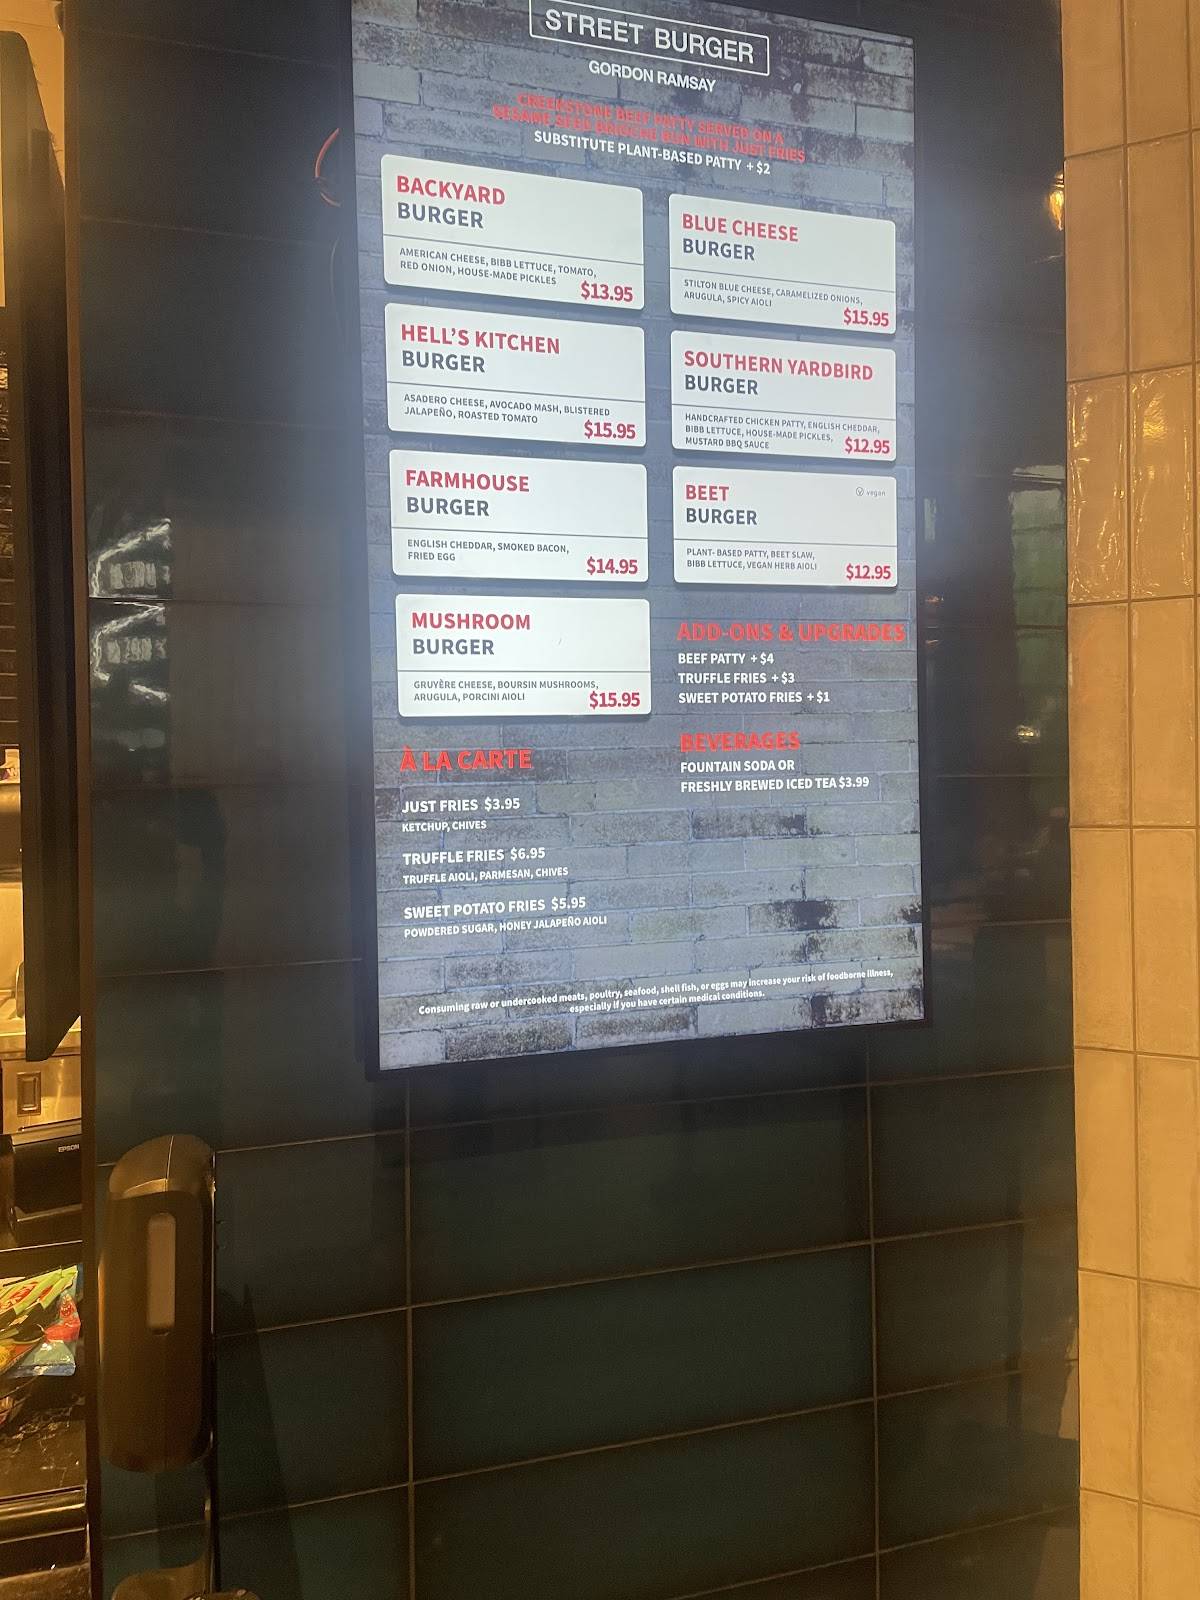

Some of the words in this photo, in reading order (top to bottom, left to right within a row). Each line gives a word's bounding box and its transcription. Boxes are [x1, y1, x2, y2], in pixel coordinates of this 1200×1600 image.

[545, 9, 643, 44] STREET
[655, 27, 753, 64] BURGER
[588, 60, 653, 83] GORDON
[657, 70, 716, 92] RAMSAY
[534, 130, 614, 153] SUBSTITUTE
[617, 142, 702, 165] PLANT-BASED
[705, 154, 741, 170] PATTY
[756, 160, 770, 175] $2
[768, 144, 805, 161] FRIES
[396, 175, 505, 205] BACKYARD
[397, 201, 483, 229] BURGER
[682, 213, 727, 234] BLUE
[732, 219, 798, 242] CHEESE
[682, 237, 754, 261] BURGER
[399, 247, 448, 261] AMERICAN
[450, 252, 489, 267] CHEESE,
[490, 257, 512, 268] BIBB
[513, 259, 556, 275] LETTUCE,
[557, 264, 596, 279] TOMATO,
[400, 259, 419, 270] RED
[420, 262, 455, 276] ONION,
[457, 266, 517, 281] HOUSE-MADE
[519, 273, 556, 285] PICKLES
[580, 279, 633, 302] $13.95
[683, 278, 717, 290] STILTON
[718, 282, 739, 292] BLUE
[740, 284, 774, 298] CHEESE,
[775, 288, 828, 301] CARAMELIZED
[830, 293, 863, 306] ONIONS,
[683, 290, 725, 304] ARUGULA,
[726, 295, 749, 305] SPICY
[750, 297, 772, 307] AIOLI
[843, 306, 889, 327] $15.95
[475, 330, 559, 354] KITCHEN
[402, 349, 485, 373] BURGER
[684, 350, 782, 374] SOUTHERN
[787, 359, 873, 380] YARDBIRD
[684, 374, 758, 395] BURGER
[403, 393, 447, 405] ASADERO
[449, 396, 488, 409] CHEESE,
[489, 399, 532, 411] AVOCADO
[534, 403, 562, 414] MASH,
[563, 405, 610, 416] BLISTERED
[404, 406, 456, 419] JALAPEÑO,
[457, 410, 500, 421] ROASTED
[501, 413, 538, 424] TOMATO
[685, 412, 744, 424] HANDCRAFTED
[745, 416, 780, 427] CHICKEN
[781, 419, 806, 430] PATTY,
[807, 420, 840, 430] ENGLISH
[842, 423, 880, 434] CHEDDAR,
[583, 419, 636, 439] $15.95
[685, 424, 704, 433] BIBB
[706, 425, 744, 438] LETTUCE,
[745, 428, 797, 439] HOUSE-MADE
[798, 431, 833, 443] PICKLES,
[685, 436, 724, 446] MUSTARD
[725, 438, 742, 449] BBQ
[744, 440, 769, 449] SAUCE
[844, 435, 890, 454] $12.95
[405, 469, 529, 492] FARMHOUSE
[685, 484, 729, 501] BEET
[406, 496, 489, 516] BURGER
[686, 507, 757, 525] BURGER
[407, 538, 447, 548] ENGLISH
[449, 540, 496, 552] CHEDDAR,
[497, 542, 535, 552] SMOKED
[536, 543, 569, 555] BACON,
[407, 551, 435, 560] FRIED
[437, 552, 455, 561] EGG
[744, 549, 769, 559] PATTY,
[770, 550, 790, 558] BEET
[791, 550, 815, 560] SLAW,
[586, 555, 638, 576] $14.95
[686, 559, 706, 568] BIBB
[707, 559, 745, 570] LETTUCE,
[746, 560, 772, 569] VEGAN
[774, 561, 795, 570] HERB
[796, 562, 817, 570] AIOLI
[846, 563, 891, 580] $12.95
[411, 612, 530, 630] MUSHROOM
[677, 623, 773, 641] ADD-ONS
[798, 623, 905, 641] UPGRADES
[412, 638, 494, 655] BURGER
[678, 652, 708, 664] BEEF
[710, 652, 745, 664] PATTY
[759, 651, 774, 665] $4
[413, 678, 456, 689] GRUYÈRE
[458, 680, 496, 690] CHEESE,
[497, 680, 537, 689] BOURSIN
[539, 680, 599, 690] MUSHROOMS,
[677, 672, 731, 684] TRUFFLE
[733, 672, 767, 684] FRIES
[781, 671, 795, 685] $3
[413, 692, 460, 702] ARUGULA,
[462, 692, 499, 701] PORCINI
[501, 692, 525, 701] AIOLI
[589, 690, 640, 709] $15.95
[678, 692, 719, 703] SWEET
[721, 691, 767, 703] POTATO
[769, 691, 802, 702] FRIES
[816, 689, 830, 704] $1
[680, 731, 800, 752] BEVERAGES
[399, 746, 417, 772] À
[421, 750, 452, 772] LA
[456, 748, 532, 770] CARTE
[680, 760, 741, 773] FOUNTAIN
[743, 759, 776, 771] SODA
[777, 759, 795, 770] OR
[680, 780, 732, 793] FRESHLY
[734, 778, 784, 791] BREWED
[786, 777, 813, 789] ICED
[814, 777, 837, 788] TEA
[838, 775, 869, 789] $3.99
[401, 800, 436, 813] JUST
[439, 798, 478, 812] FRIES
[484, 796, 520, 812] $3.95
[401, 821, 450, 832] KETCHUP,
[451, 819, 487, 830] CHIVES
[402, 850, 463, 865] TRUFFLE
[466, 848, 504, 862] FRIES
[510, 846, 545, 861] $6.95
[402, 872, 446, 884] TRUFFLE
[447, 871, 478, 882] AIOLI,
[479, 868, 534, 880] PARMESAN,
[534, 866, 568, 877] CHIVES
[403, 904, 450, 919] SWEET
[453, 901, 505, 916] POTATO
[508, 898, 545, 912] FRIES
[551, 896, 586, 912] $5.95
[403, 925, 460, 938] POWDERED
[461, 922, 497, 934] SUGAR,
[499, 920, 532, 932] HONEY
[533, 915, 581, 929] JALAPEÑO
[582, 915, 607, 926] AIOLI
[418, 1001, 470, 1015] Consuming
[500, 993, 557, 1007] undercooked
[558, 991, 588, 1002] meats,
[589, 989, 623, 1003] poultry,
[801, 973, 816, 982] risk
[569, 1001, 612, 1014] especially
[637, 998, 657, 1007] have
[721, 989, 765, 1000] conditions.
[58, 1144, 80, 1153] EPSON
